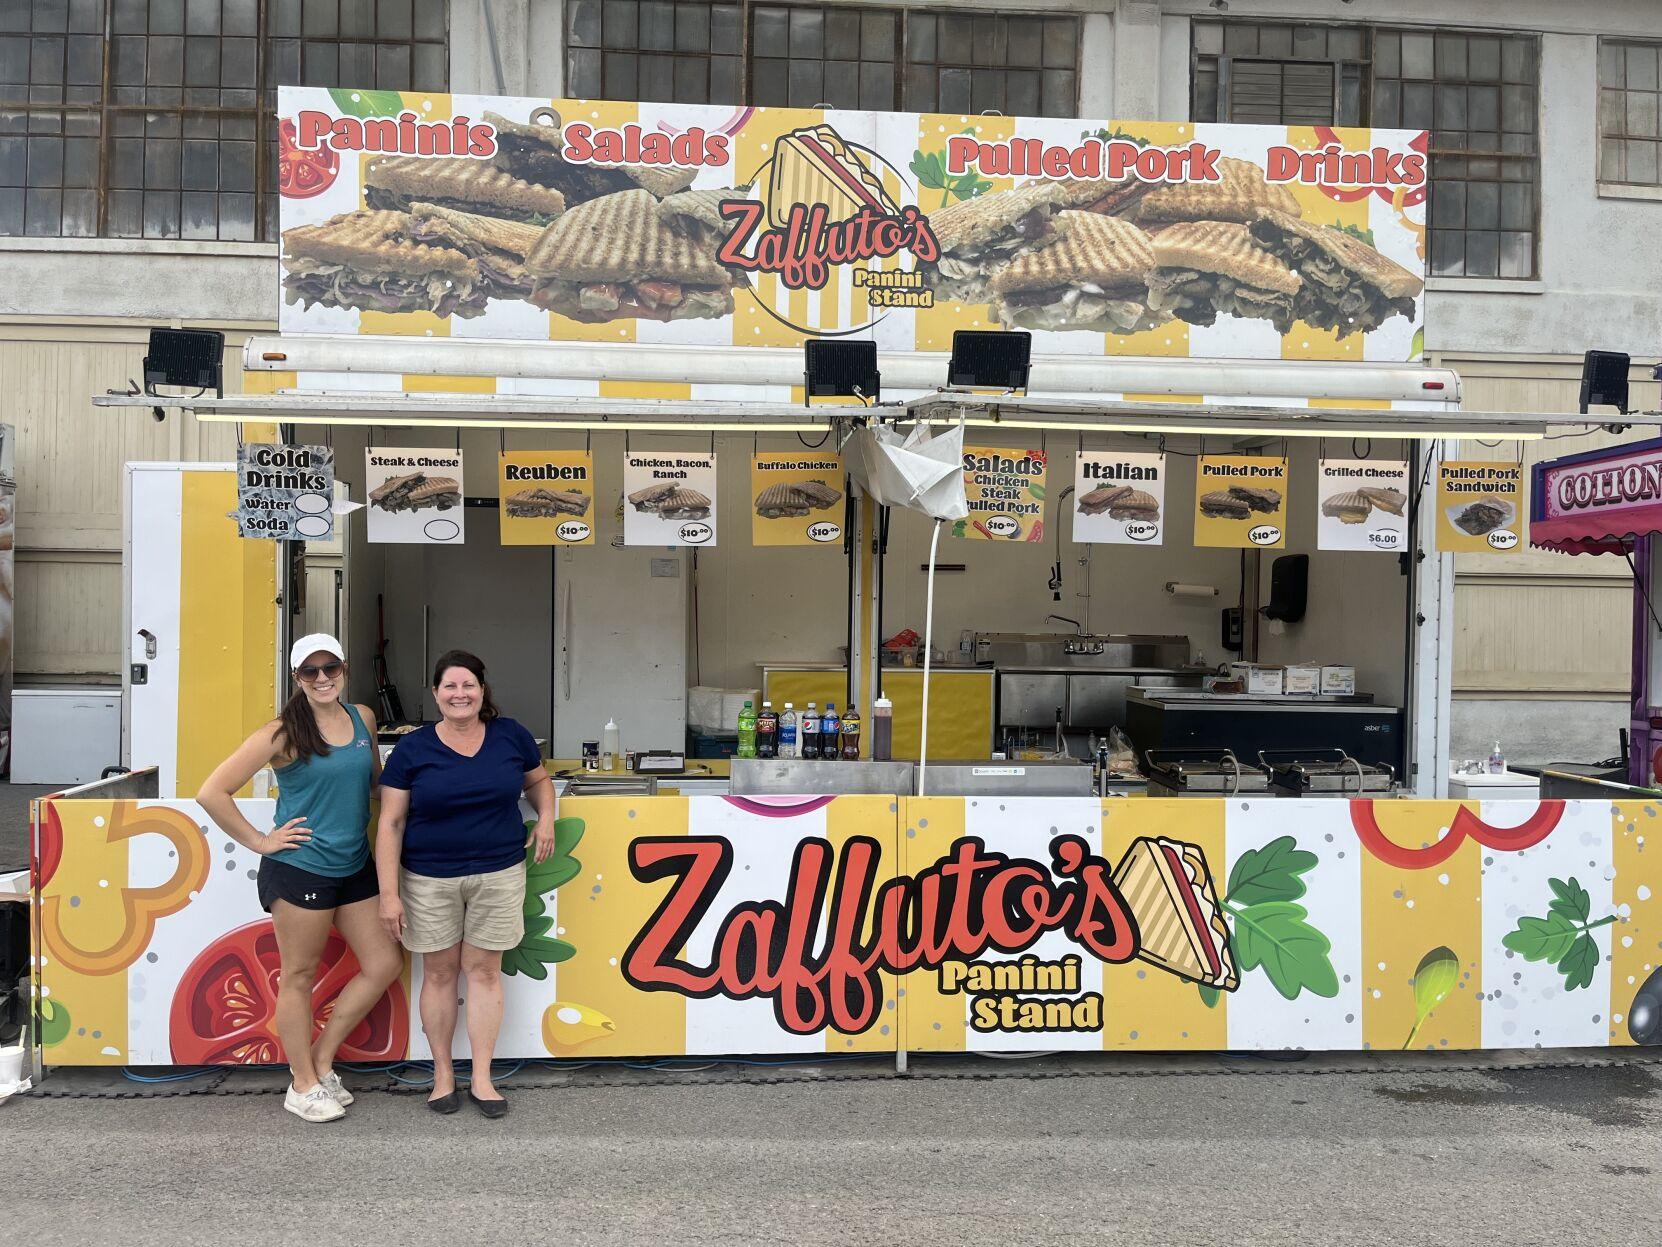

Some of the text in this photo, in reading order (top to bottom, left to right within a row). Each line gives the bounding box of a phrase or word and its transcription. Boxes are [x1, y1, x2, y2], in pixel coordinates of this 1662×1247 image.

[298, 111, 730, 168] Paninis Salads
[948, 136, 1221, 182] Pulled Pork
[1266, 144, 1426, 185] Drinks
[718, 203, 940, 289] Zaffuto's
[853, 268, 923, 288] Panini
[871, 289, 933, 308] Stand
[256, 449, 310, 468] Cold
[370, 456, 459, 468] Steak & Cheese
[629, 458, 712, 469] Chicken, Bacon,
[757, 460, 838, 471] Buffalo Chicken
[962, 454, 1043, 475] Salads
[506, 464, 587, 480] Reuben
[653, 470, 688, 479] Ranch
[1083, 463, 1158, 481] Italian
[1203, 464, 1284, 478] Pulled Pork
[1324, 467, 1404, 478] Grilled Cheese
[1441, 468, 1520, 480] Pulled Pork
[246, 470, 326, 490] Drinks
[974, 475, 1029, 488] Chicken
[1446, 481, 1516, 493] Sandwich
[1559, 462, 1662, 509] COTTON
[981, 487, 1021, 499] Steak
[245, 498, 291, 511] Water
[1007, 502, 1040, 514] Pork
[246, 517, 289, 531] Soda
[1368, 533, 1397, 543] $6.00
[625, 836, 1138, 1033] Zaffuto's
[941, 957, 1078, 992] Panini
[974, 997, 1101, 1030] Stand
